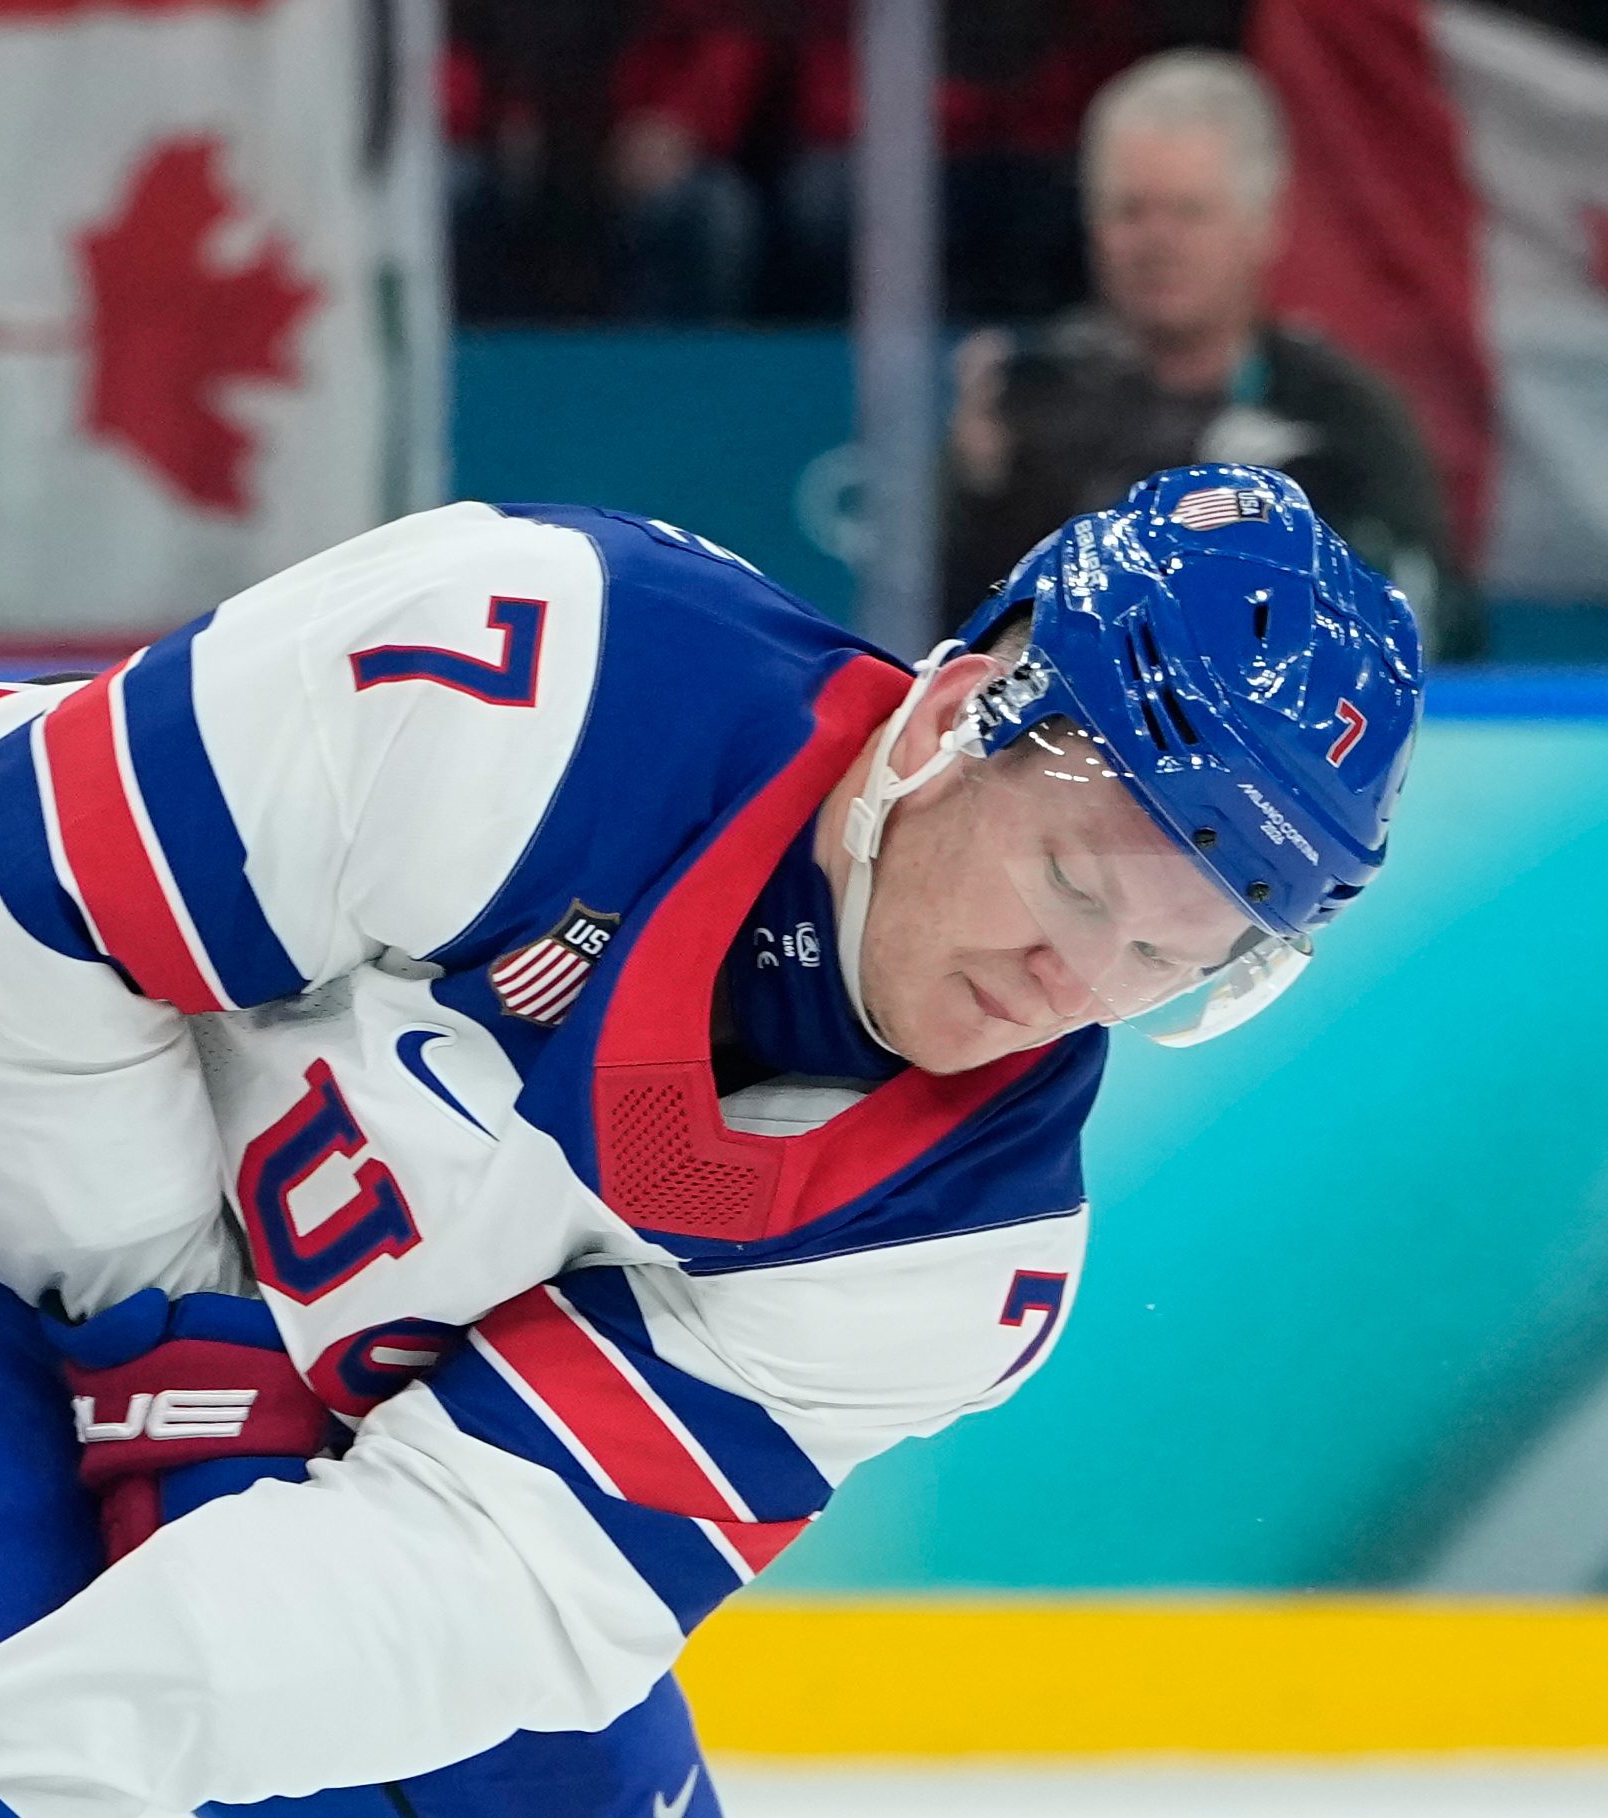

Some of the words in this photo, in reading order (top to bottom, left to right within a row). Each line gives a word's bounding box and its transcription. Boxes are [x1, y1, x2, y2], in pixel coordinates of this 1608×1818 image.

[351, 595, 548, 707] 7
[1325, 696, 1368, 769] 7
[564, 918, 612, 959] US
[996, 1270, 1069, 1391] 7
[71, 1389, 260, 1443] UE
